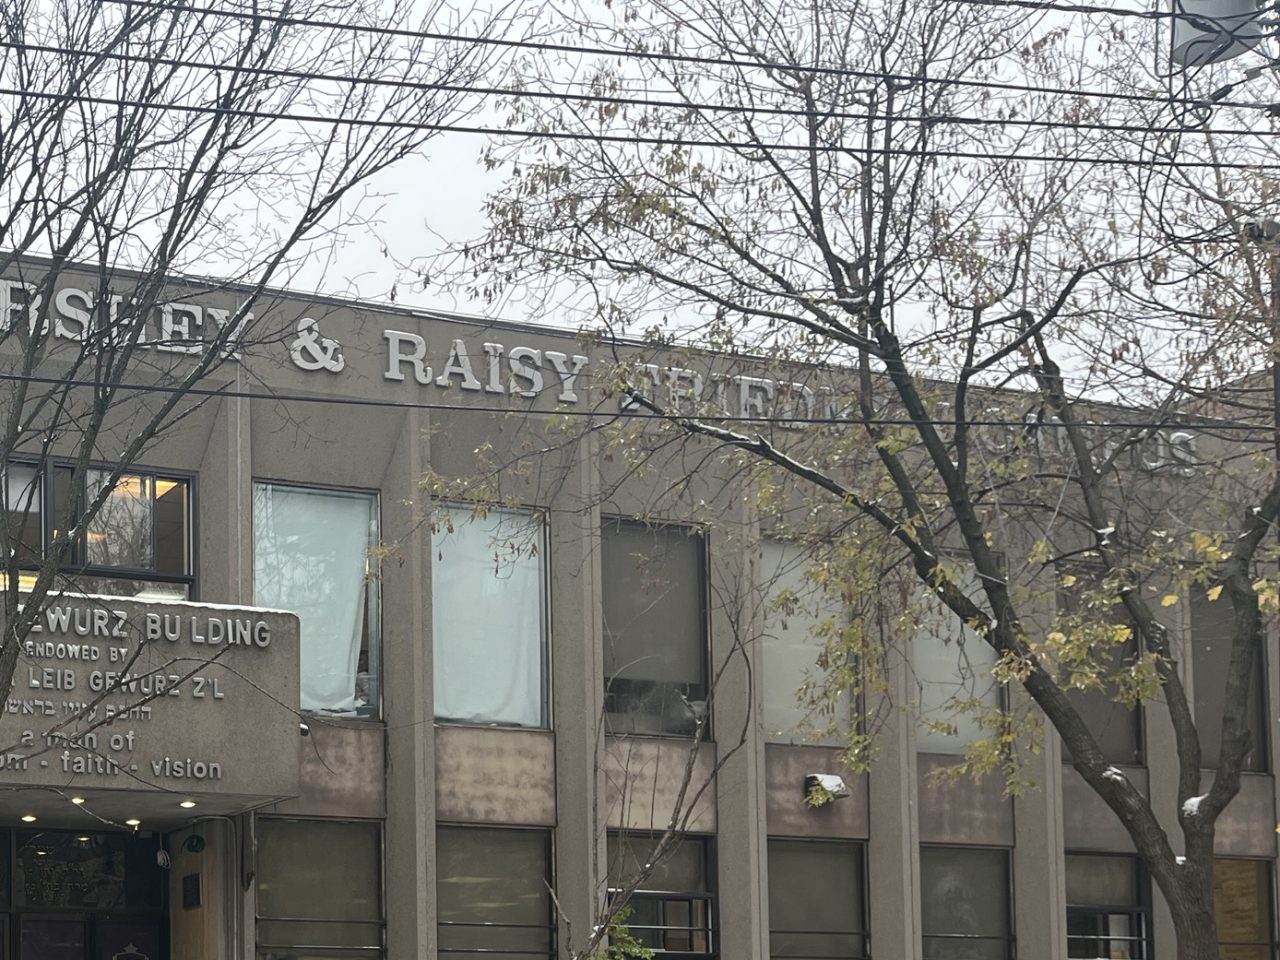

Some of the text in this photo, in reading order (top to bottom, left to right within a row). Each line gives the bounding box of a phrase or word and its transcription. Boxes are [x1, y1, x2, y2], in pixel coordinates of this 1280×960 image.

[290, 317, 345, 373] &
[382, 329, 590, 403] RAISY
[18, 604, 129, 639] WURZ
[25, 640, 129, 662] ENDOWED BY
[28, 667, 76, 690] LEIB
[89, 671, 181, 697] GEWURZ
[43, 732, 97, 750] man
[110, 730, 135, 751] of
[60, 751, 119, 776] faith
[151, 757, 222, 779] vision
